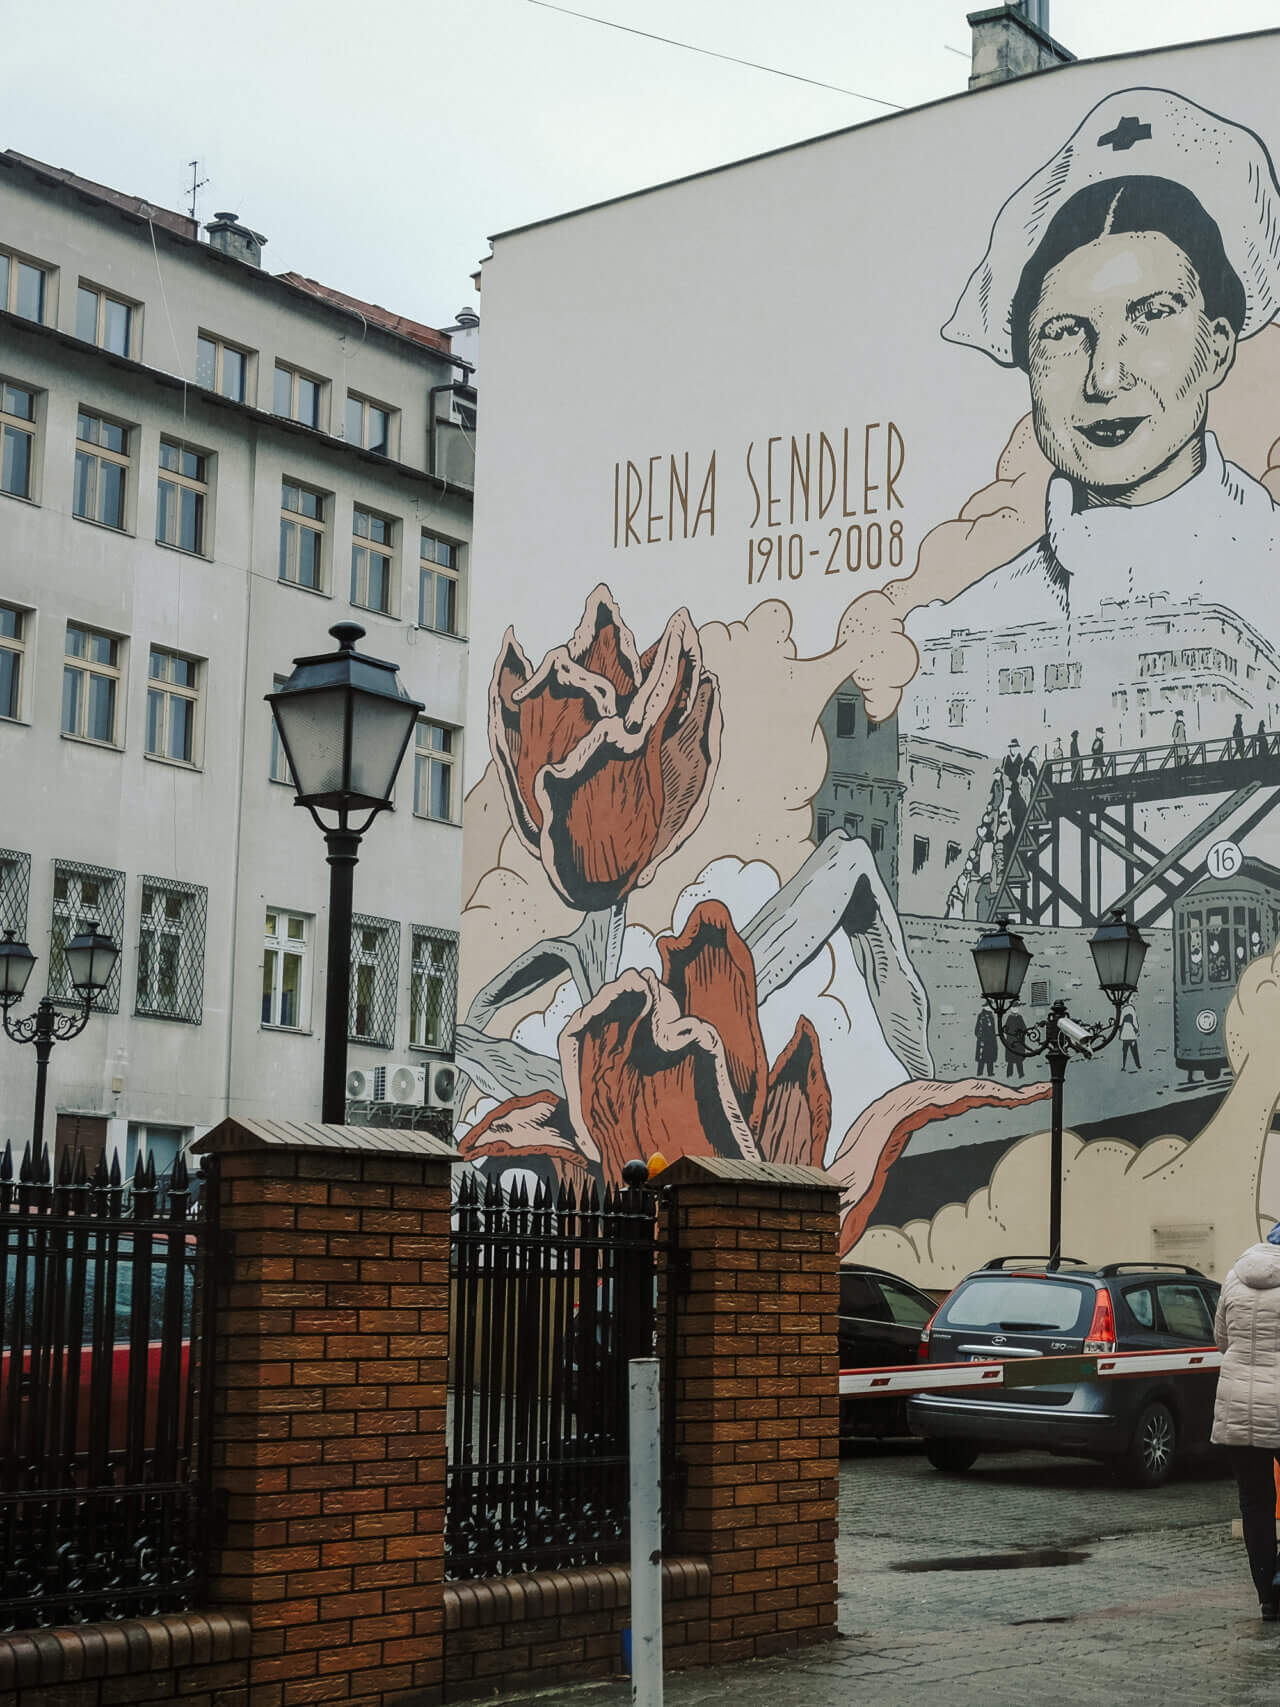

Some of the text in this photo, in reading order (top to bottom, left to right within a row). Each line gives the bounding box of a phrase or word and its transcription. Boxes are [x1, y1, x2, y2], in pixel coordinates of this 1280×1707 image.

[613, 421, 905, 549] IRENA SENDLER
[747, 519, 904, 585] 1910-2008
[1213, 848, 1235, 873] 16
